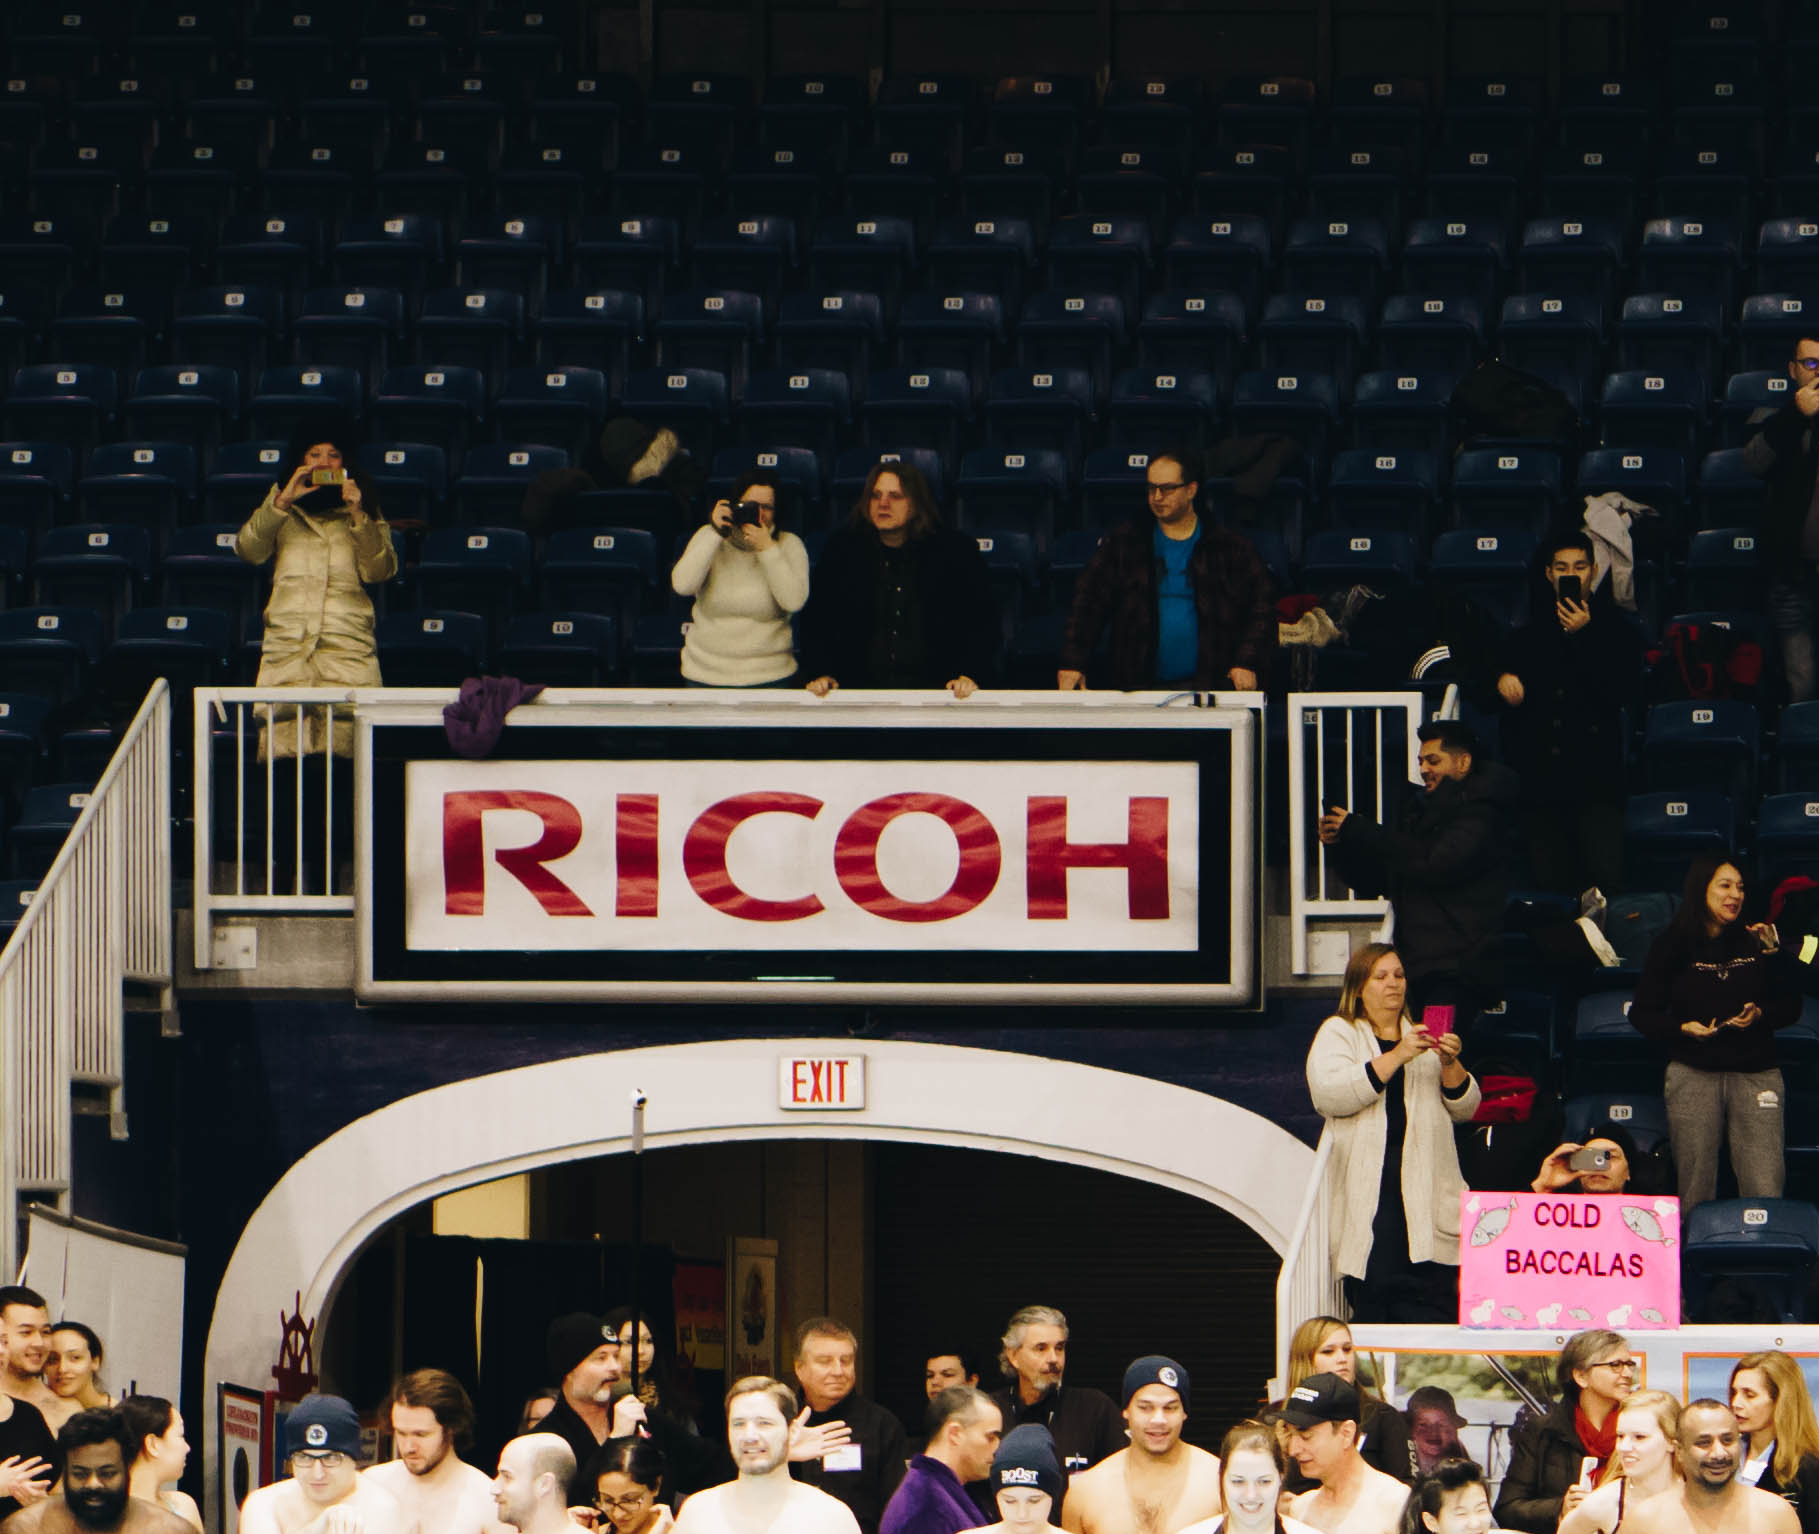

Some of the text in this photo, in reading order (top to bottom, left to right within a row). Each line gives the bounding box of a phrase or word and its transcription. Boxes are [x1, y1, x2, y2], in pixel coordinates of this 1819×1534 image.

[443, 790, 1170, 924] RICOH
[792, 1060, 850, 1104] EXIT
[1534, 1202, 1601, 1228] COLD
[1506, 1249, 1644, 1278] BACCALAS
